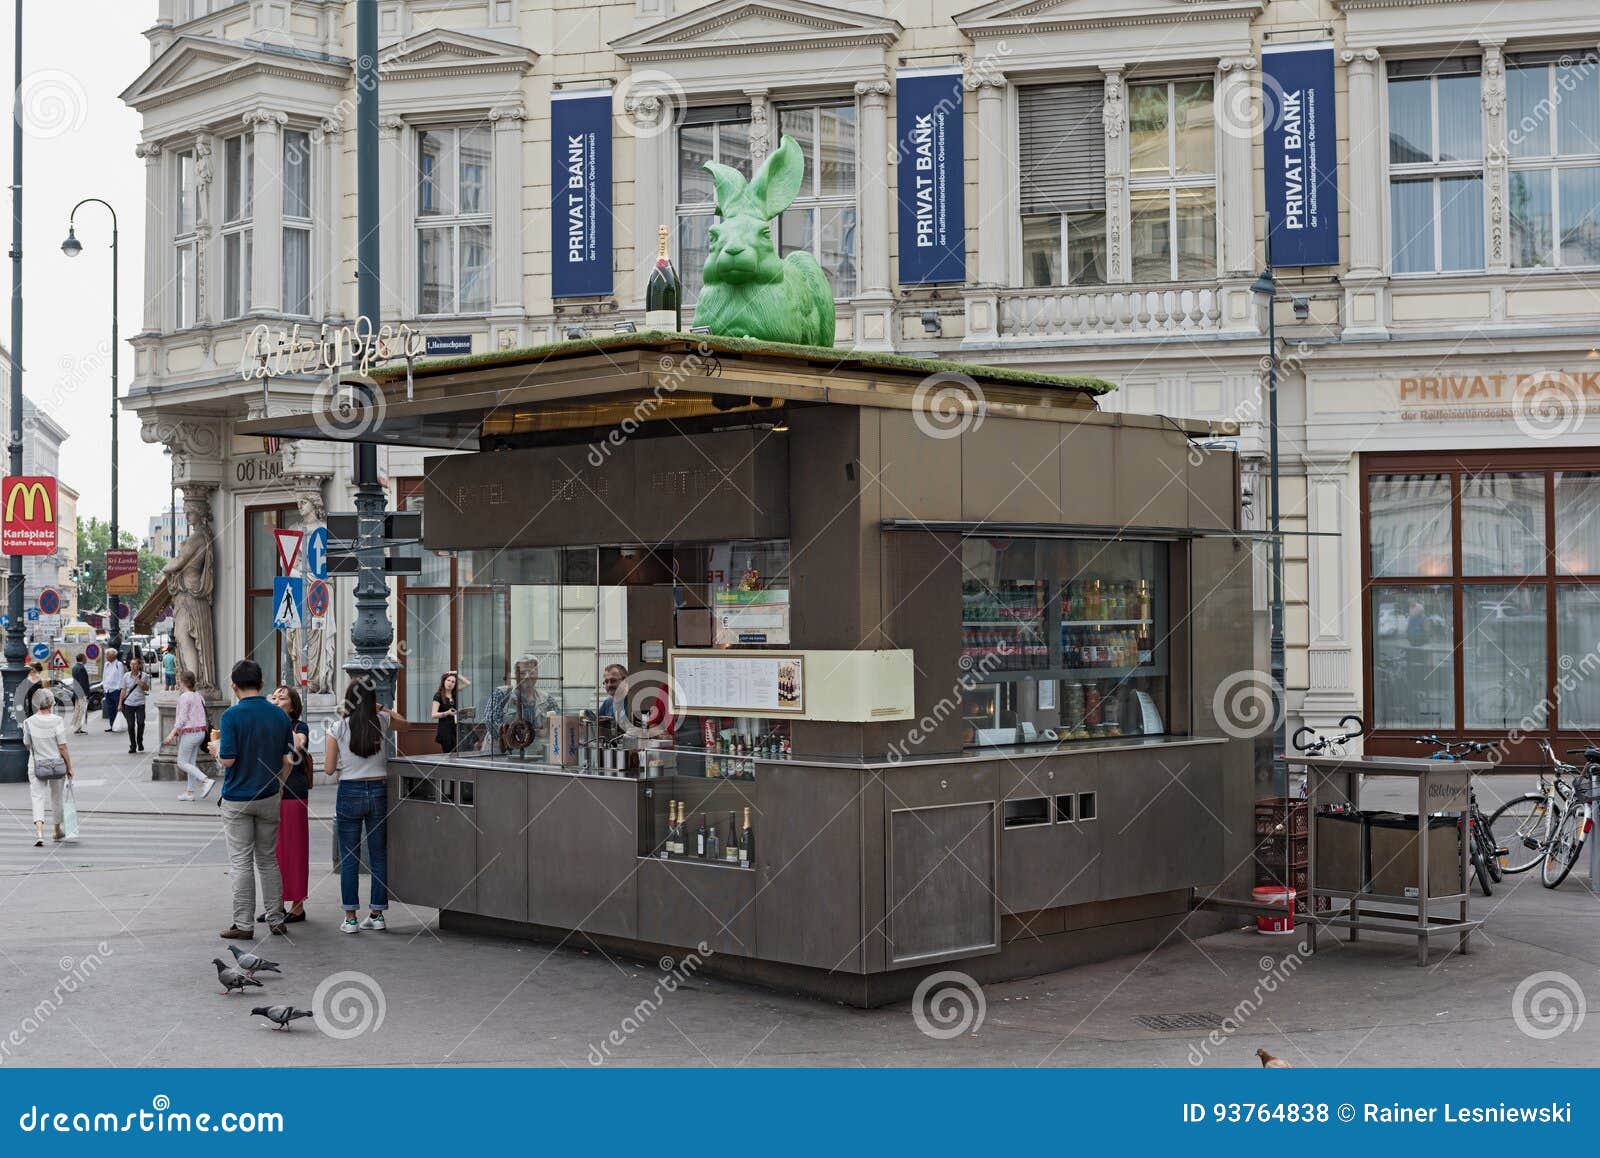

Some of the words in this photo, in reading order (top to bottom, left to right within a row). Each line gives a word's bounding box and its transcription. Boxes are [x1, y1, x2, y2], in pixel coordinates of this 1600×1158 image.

[915, 113, 932, 170] BANK
[1282, 90, 1301, 150] BANK
[568, 134, 583, 189] BANK
[917, 175, 933, 247] PRIVAT
[1285, 155, 1303, 229] PRIVAT
[568, 194, 583, 262] PRIVAT
[1400, 374, 1508, 401] PRIVAT
[1401, 410, 1417, 420] der
[236, 459, 255, 481] OÖ
[3, 529, 55, 540] Karlsplatz
